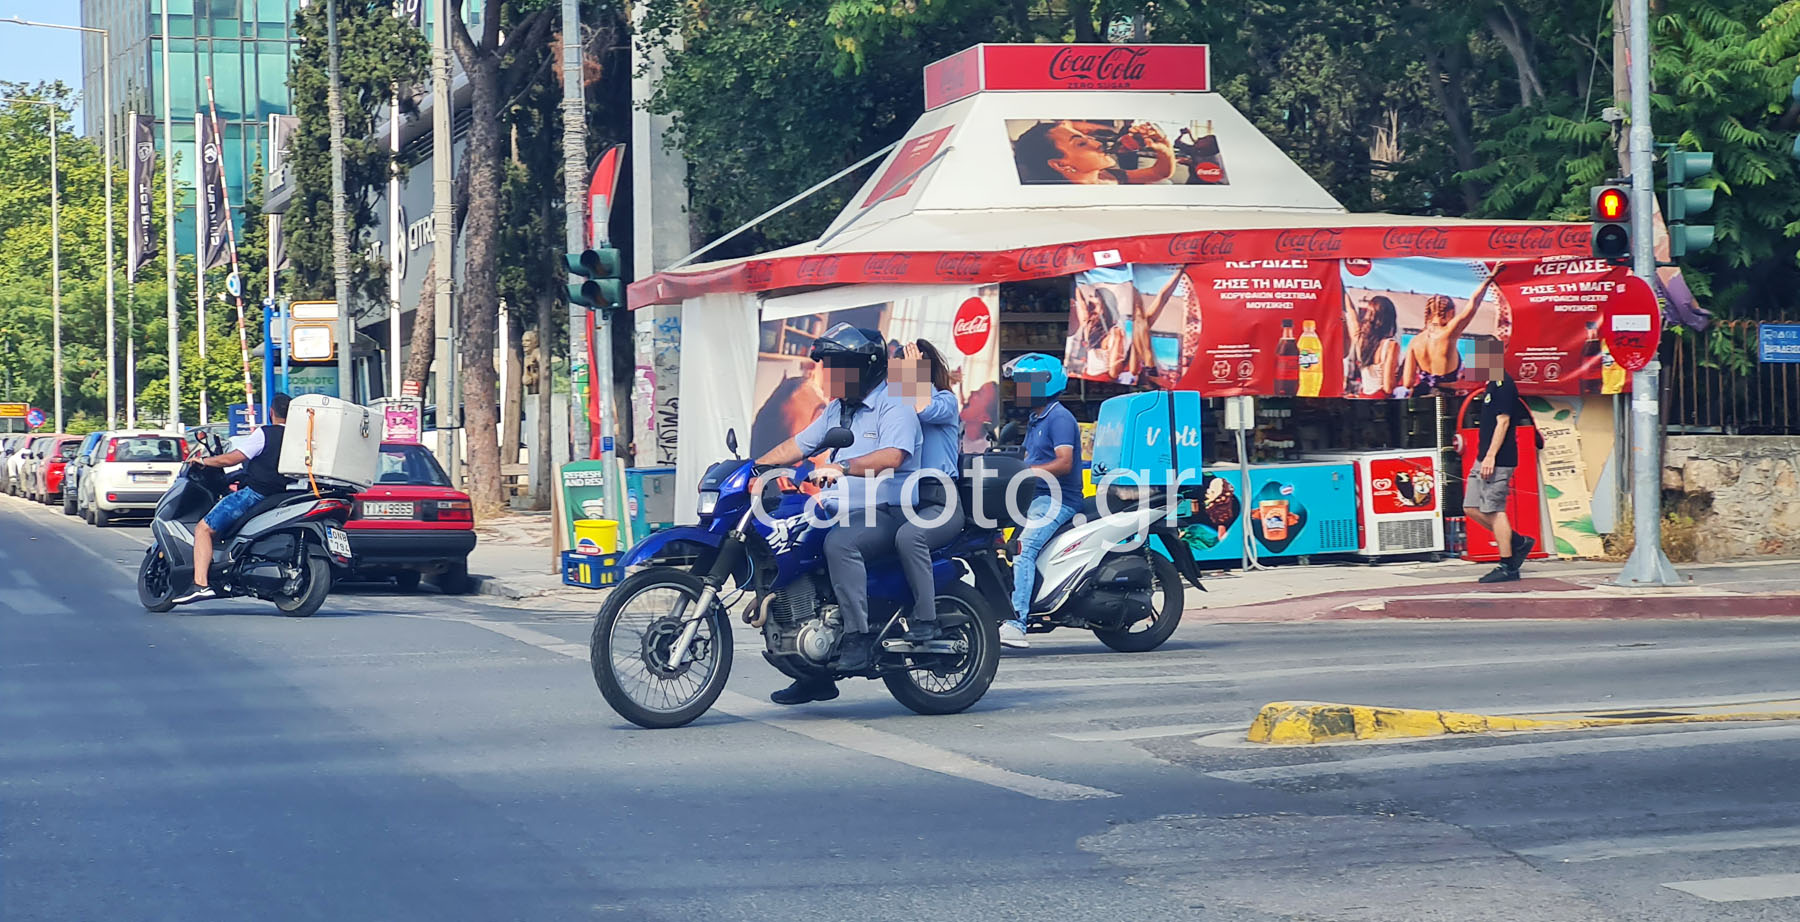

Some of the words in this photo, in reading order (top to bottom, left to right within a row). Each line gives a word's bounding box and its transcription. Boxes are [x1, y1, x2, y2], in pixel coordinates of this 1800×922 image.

[1049, 48, 1151, 80] Coca-Cola
[1168, 231, 1235, 256] Coca-Cola
[1275, 228, 1343, 252] Coca-Cola
[1383, 226, 1449, 250] Coca-Cola
[1488, 226, 1554, 250] Coca-Cola
[1018, 244, 1086, 272] Coca-Cola
[1213, 279, 1249, 289] ΖΗΣΕ
[1251, 279, 1270, 288] ΤΗ
[1273, 279, 1322, 289] ΜΑΓΕΙΑ
[1520, 285, 1556, 294] ΖΗΣΕ
[1558, 283, 1577, 292] ΤΗ
[1580, 281, 1615, 291] ΜΑΓΕ
